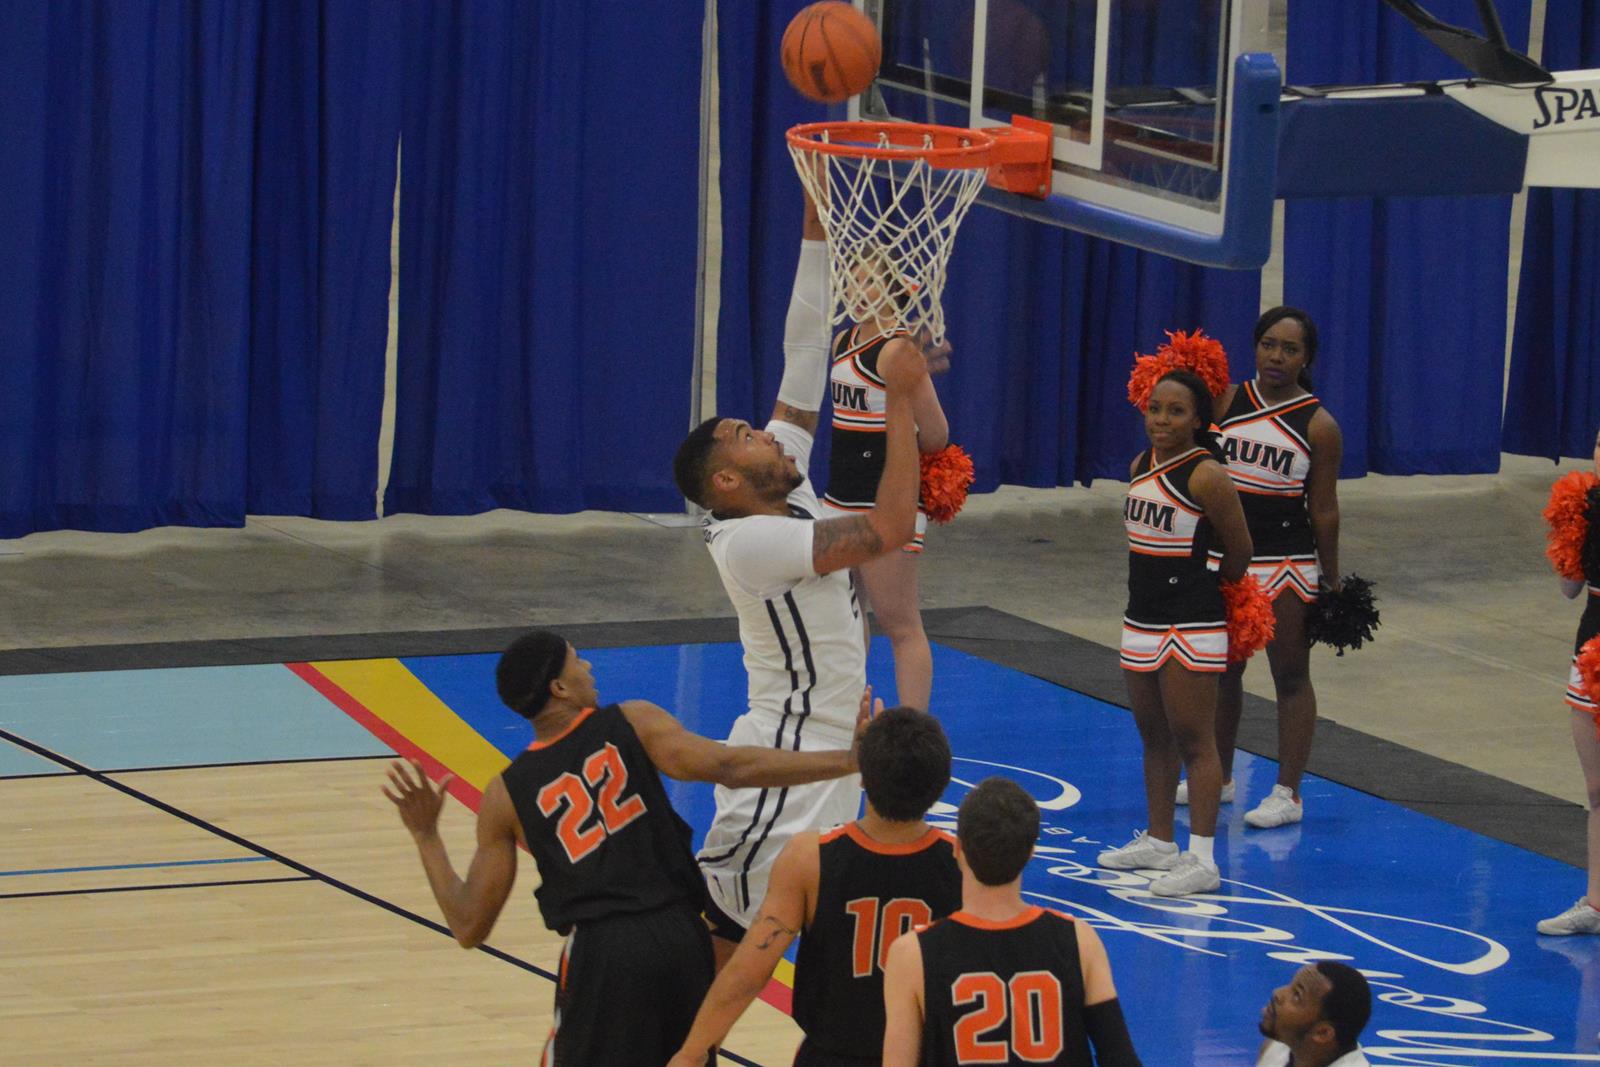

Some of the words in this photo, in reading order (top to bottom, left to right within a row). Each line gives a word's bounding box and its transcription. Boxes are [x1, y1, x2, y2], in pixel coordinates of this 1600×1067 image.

[1533, 86, 1600, 129] SPA
[1222, 436, 1297, 477] AUM
[536, 741, 647, 864] 22
[846, 897, 932, 978] 10
[951, 970, 1064, 1064] 20
